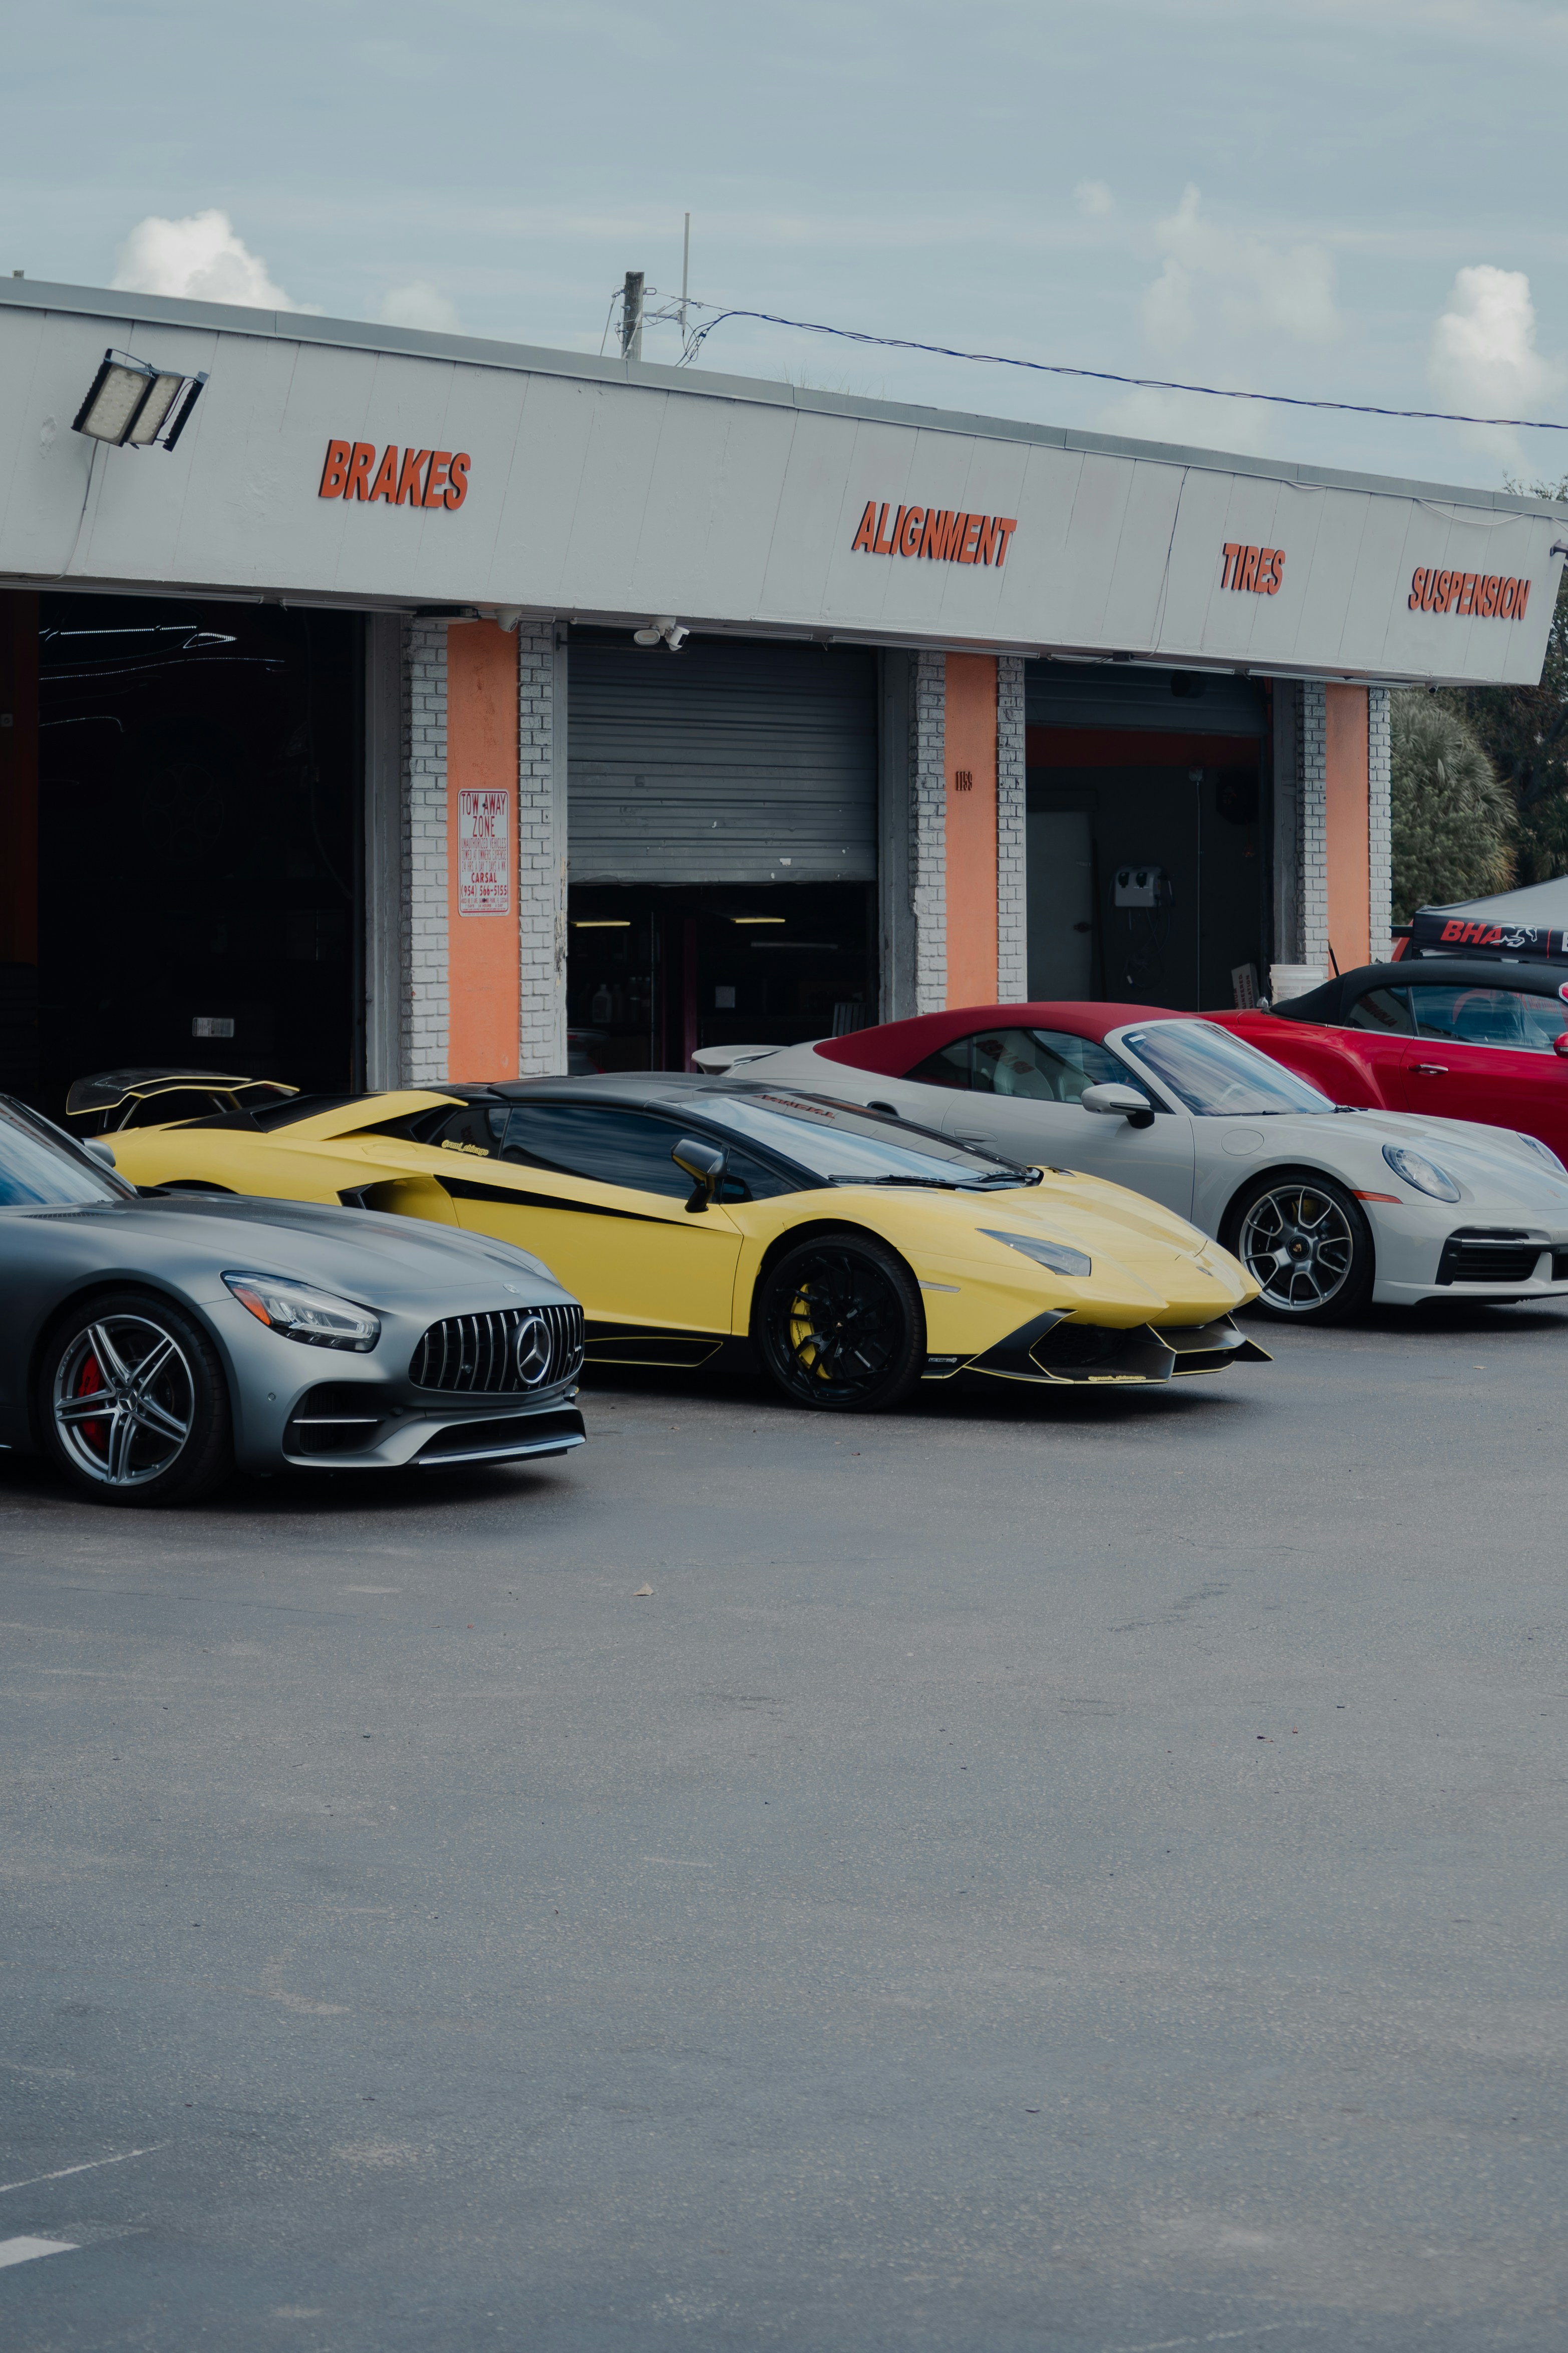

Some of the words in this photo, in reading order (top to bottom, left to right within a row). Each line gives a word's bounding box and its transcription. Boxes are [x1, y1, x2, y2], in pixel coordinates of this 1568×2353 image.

[319, 439, 471, 510] BRAKES
[851, 501, 1018, 567] ALIGNMENT
[1220, 543, 1285, 595] TIRES
[1408, 567, 1531, 620] SUSPENSION
[461, 794, 479, 816] TOW
[484, 793, 506, 816] AWAY
[473, 816, 495, 838] ZONE
[461, 838, 488, 849] UNAUTHORIZED
[490, 838, 506, 849] VEHICLES
[461, 850, 472, 860] TOWED
[473, 850, 477, 860] AT
[478, 850, 491, 860] OWNERS
[493, 849, 506, 860] EXPENSE
[462, 861, 466, 872] 24
[502, 861, 506, 872] WK
[471, 872, 497, 883] CARSAL
[461, 884, 477, 897] (954)
[480, 885, 507, 896] 566-5155
[1441, 920, 1502, 946] BHA
[1238, 974, 1246, 1009] GINEERED
[442, 1140, 489, 1156] @rami_chicago
